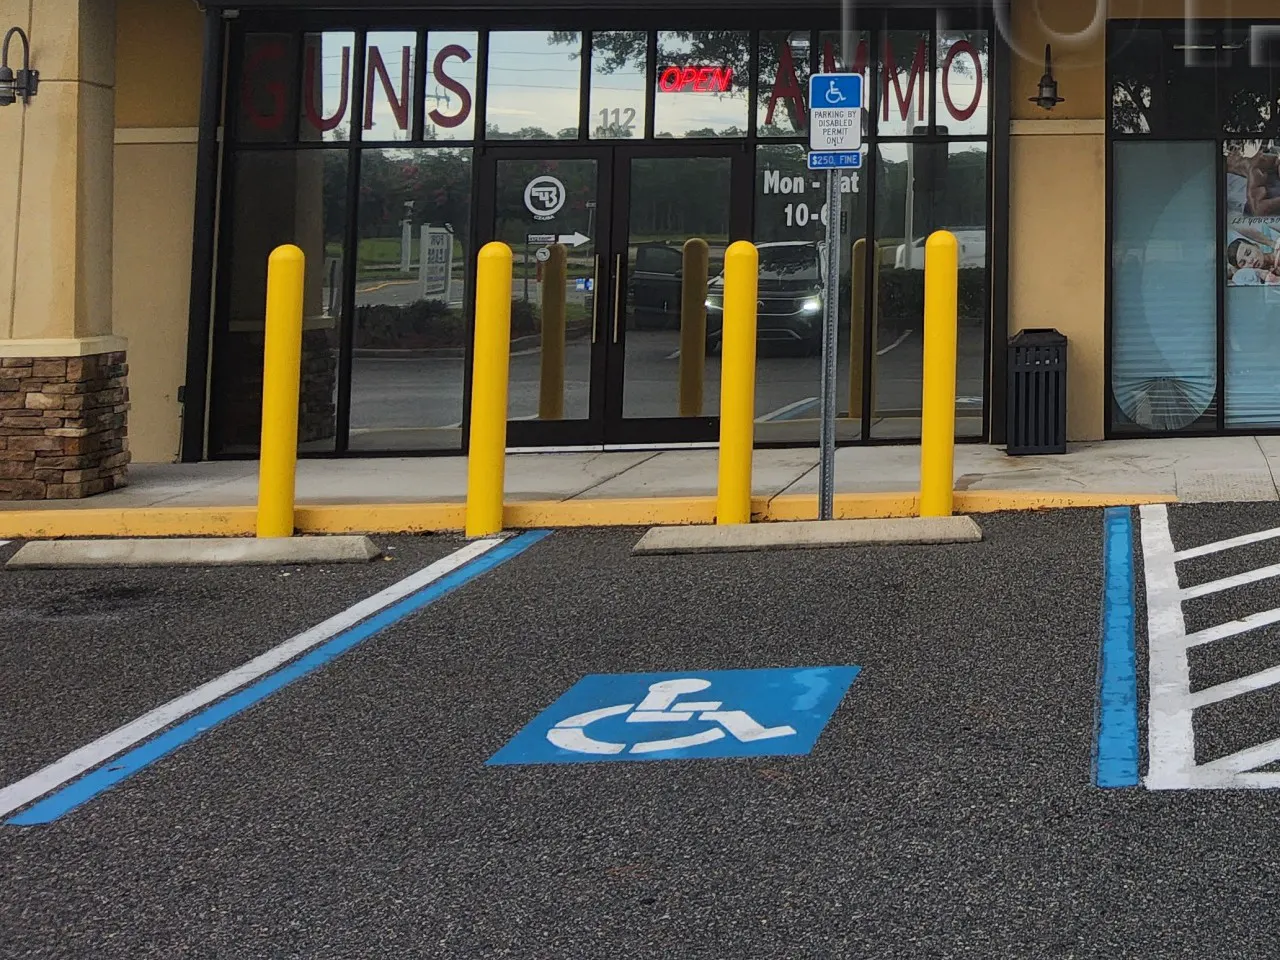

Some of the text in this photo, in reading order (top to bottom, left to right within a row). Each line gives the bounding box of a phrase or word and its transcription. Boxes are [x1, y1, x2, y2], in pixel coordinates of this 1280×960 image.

[242, 41, 472, 131] GUNS
[659, 66, 733, 93] OPEN
[599, 107, 636, 129] 112
[840, 155, 858, 164] FINE
[764, 170, 804, 194] Mon
[840, 171, 859, 193] at
